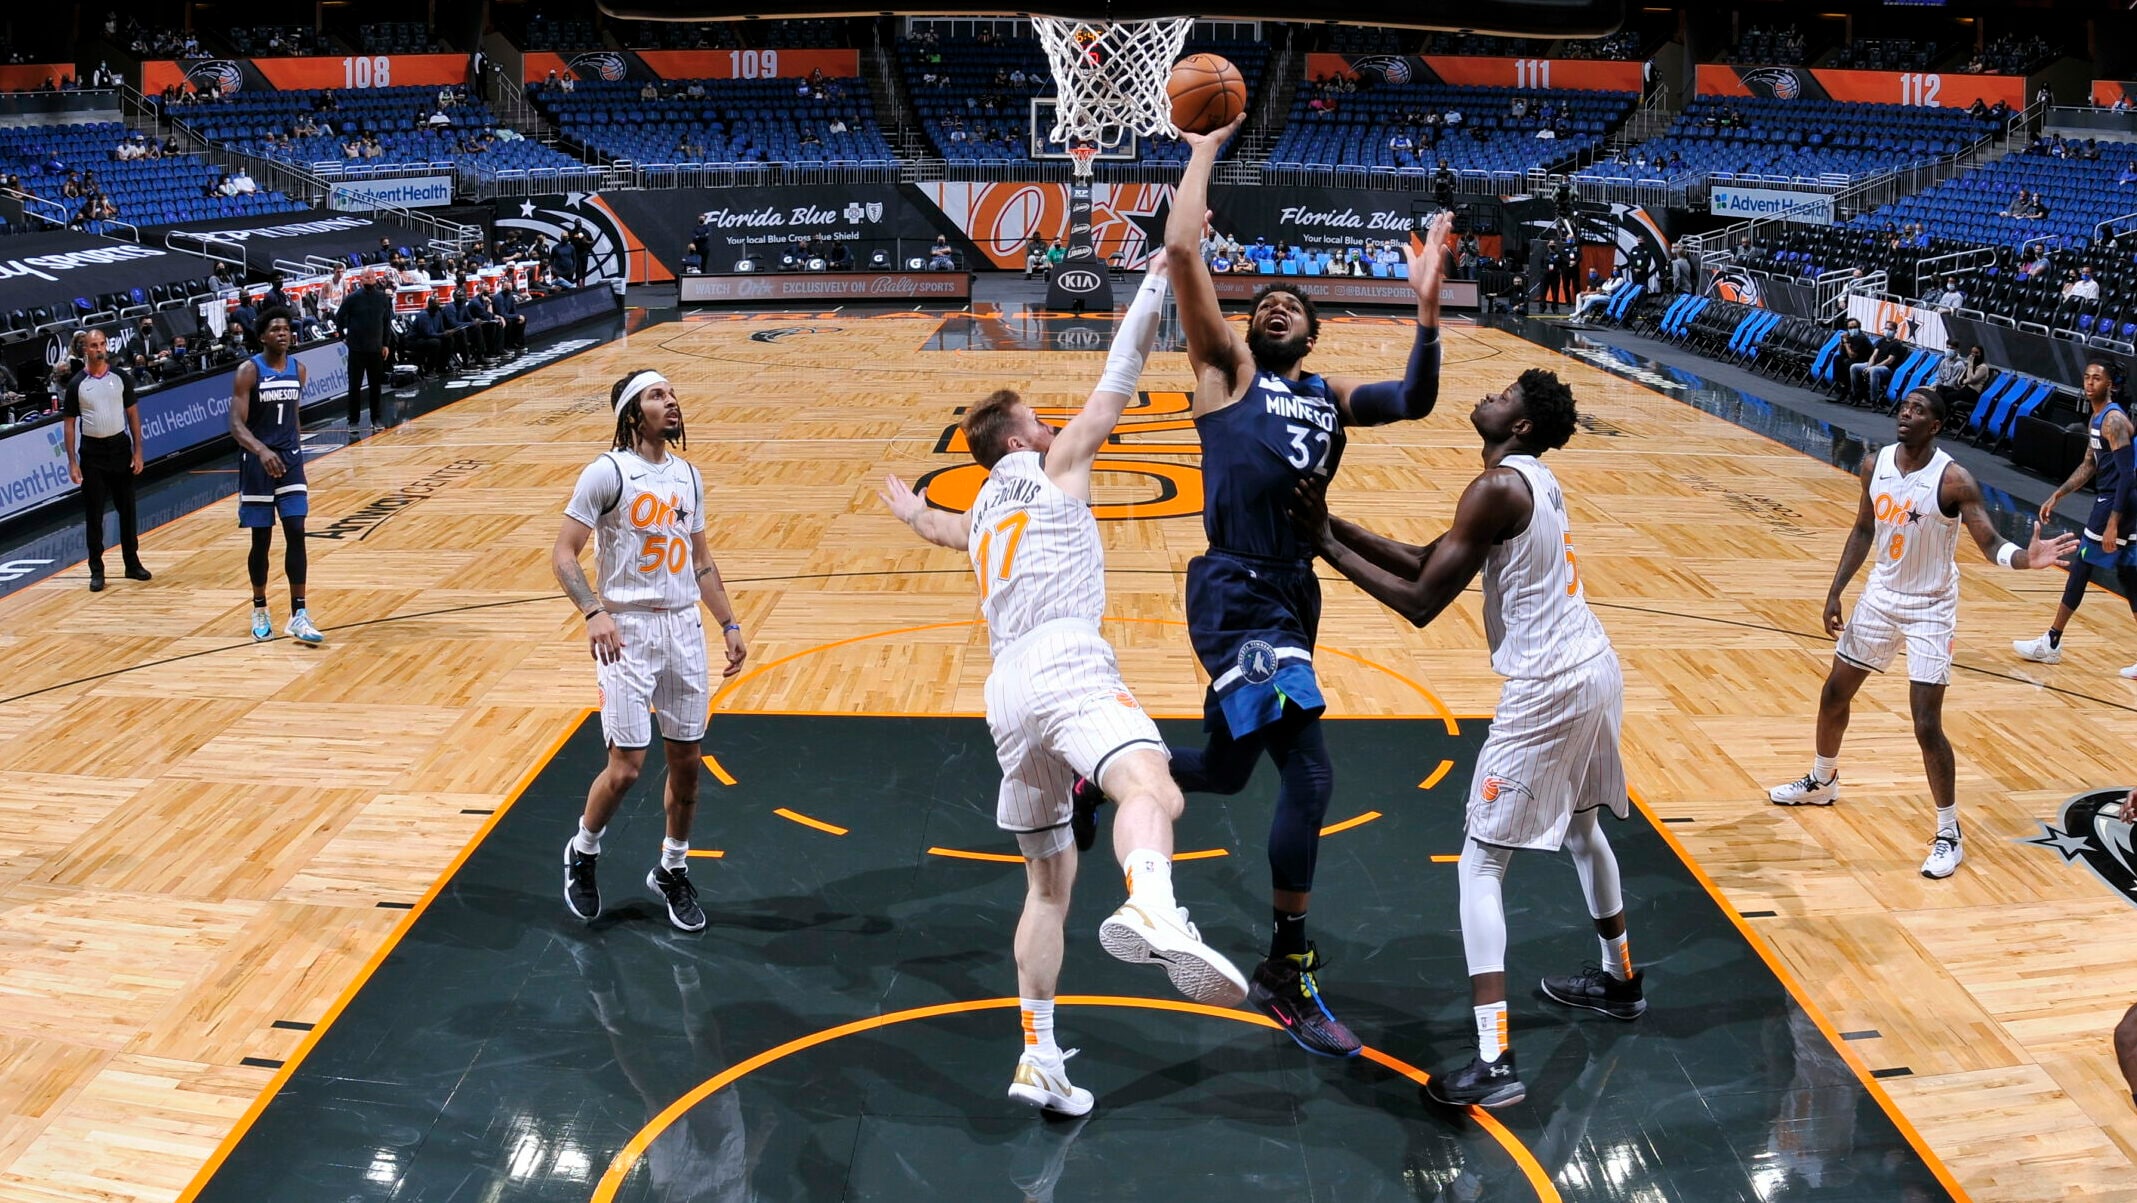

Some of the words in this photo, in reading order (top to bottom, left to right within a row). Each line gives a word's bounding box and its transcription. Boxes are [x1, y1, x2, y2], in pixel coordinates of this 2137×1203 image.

[343, 56, 390, 89] 108
[730, 50, 778, 80] 109
[1515, 59, 1550, 89] 111
[1900, 73, 1941, 107] 112
[704, 206, 785, 228] Florida
[789, 205, 837, 225] Blue
[1280, 205, 1364, 228] Florida
[1367, 210, 1414, 231] Blue
[726, 236, 745, 245] Your
[746, 235, 766, 244] local
[768, 235, 787, 243] Blue
[788, 233, 811, 242] Cross
[816, 232, 832, 241] lue
[833, 231, 860, 241] Shield
[1303, 234, 1322, 243] Your
[1323, 235, 1343, 244] local
[1345, 236, 1364, 245] Blue
[1365, 237, 1387, 247] Cros
[24, 245, 167, 269] SPORTS
[695, 283, 730, 295] WATCH
[783, 281, 849, 294] EXCLUSIVELY
[850, 281, 866, 293] ON
[871, 276, 918, 297] Bally
[919, 281, 955, 293] SPORTS
[1065, 275, 1094, 288] KIA
[164, 402, 208, 431] Health
[277, 403, 284, 425] 1
[1286, 424, 1331, 477] 32
[400, 459, 490, 493] CENTER
[638, 536, 688, 575] 50
[976, 507, 1031, 600] 17
[1889, 533, 1905, 561] 8
